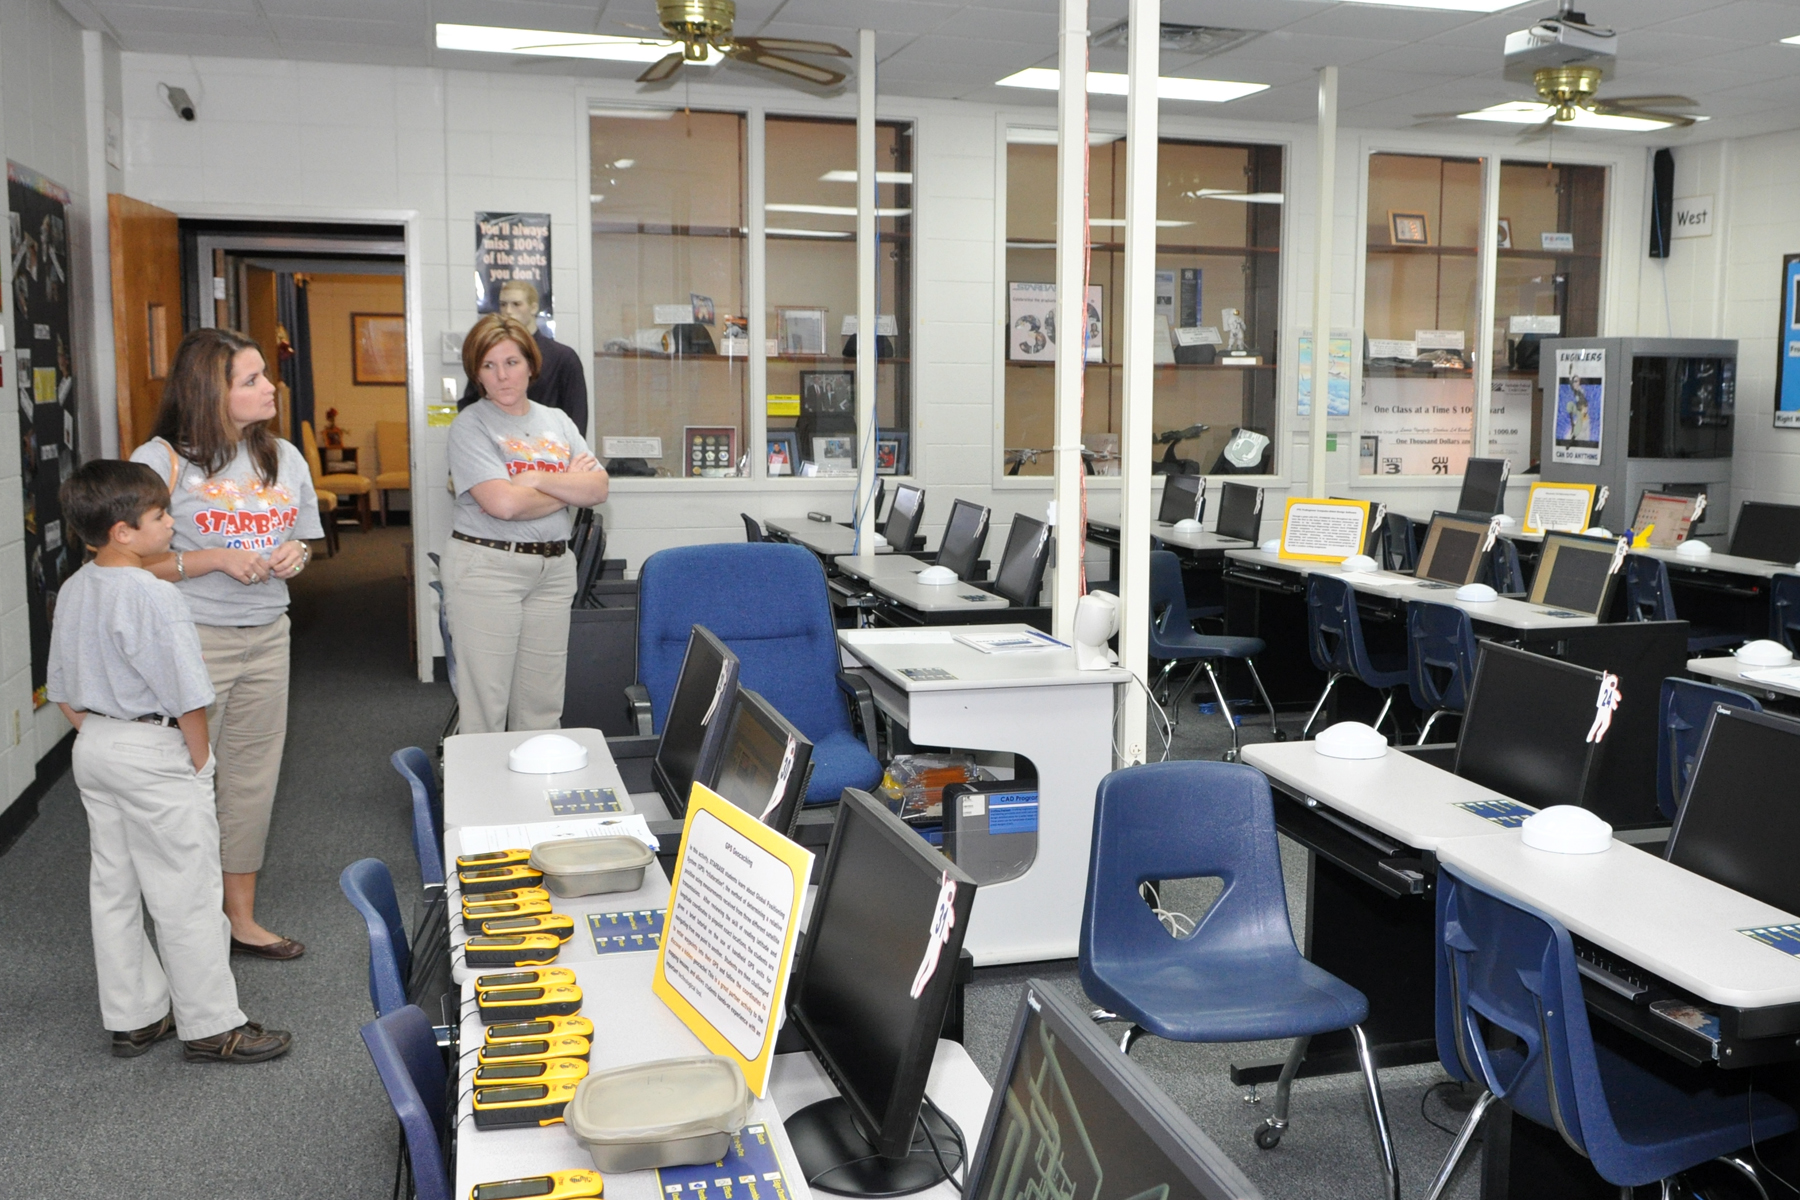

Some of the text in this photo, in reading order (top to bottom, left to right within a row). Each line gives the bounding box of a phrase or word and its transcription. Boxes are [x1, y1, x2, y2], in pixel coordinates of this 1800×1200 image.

[1677, 209, 1708, 227] West
[480, 221, 549, 238] You'll always
[483, 236, 545, 251] miss 100%
[483, 251, 547, 266] of the shots
[490, 267, 541, 282] you don't
[1374, 405, 1390, 414] One
[1391, 405, 1413, 414] Class
[1414, 406, 1423, 414] at
[1432, 405, 1450, 414] Time
[1776, 414, 1794, 424] Right
[1493, 428, 1519, 436] 1000.00
[1556, 450, 1565, 458] CAN
[1574, 452, 1599, 460] ANYTHING
[1384, 463, 1402, 475] 3
[1431, 464, 1449, 475] 21
[193, 506, 299, 536] STARBASE
[1601, 688, 1613, 708] 24
[1000, 795, 1015, 803] CAD
[733, 847, 753, 868] Geocaching
[687, 856, 697, 867] System
[731, 890, 742, 901] method
[747, 902, 765, 920] determining
[770, 919, 782, 931] relative
[698, 852, 708, 863] activity,
[709, 859, 725, 874] STARBASE
[725, 872, 737, 884] students
[738, 881, 746, 889] learn
[746, 887, 755, 896] about
[756, 893, 766, 904] Global
[767, 900, 785, 920] Positioning
[682, 879, 700, 897] transmissions.
[711, 903, 724, 918] reviewing
[744, 929, 756, 942] reading
[756, 938, 769, 952] latitude
[684, 868, 695, 879] position
[703, 882, 722, 901] measurements
[723, 898, 736, 910] received
[743, 913, 752, 923] three
[752, 920, 766, 934] different
[766, 931, 780, 944] satellite
[680, 891, 692, 904] longitude
[692, 902, 708, 917] coordinates
[711, 918, 723, 929] pinpoint
[723, 927, 732, 937] exact
[732, 934, 746, 950] locations,
[753, 952, 768, 966] students
[934, 903, 949, 939] 31
[675, 914, 688, 930] navigating
[711, 946, 722, 958] another.
[724, 956, 737, 971] Students
[751, 980, 769, 997] challenged
[697, 919, 707, 930] tutorial
[732, 948, 746, 963] handheld
[756, 969, 764, 978] units
[666, 961, 678, 974] important
[678, 972, 696, 991] technological
[670, 937, 682, 949] discover
[684, 949, 693, 960] hidden
[720, 983, 729, 993] great
[728, 991, 740, 1003] partner
[740, 1001, 753, 1016] activity
[684, 936, 697, 950] waypoints
[726, 972, 735, 983] follow
[742, 988, 761, 1006] coordinates
[668, 949, 679, 963] mapping
[679, 959, 689, 972] lessons,
[695, 974, 704, 985] allows
[705, 983, 717, 997] students
[717, 994, 730, 1009] hands-on
[731, 1007, 748, 1025] experience
